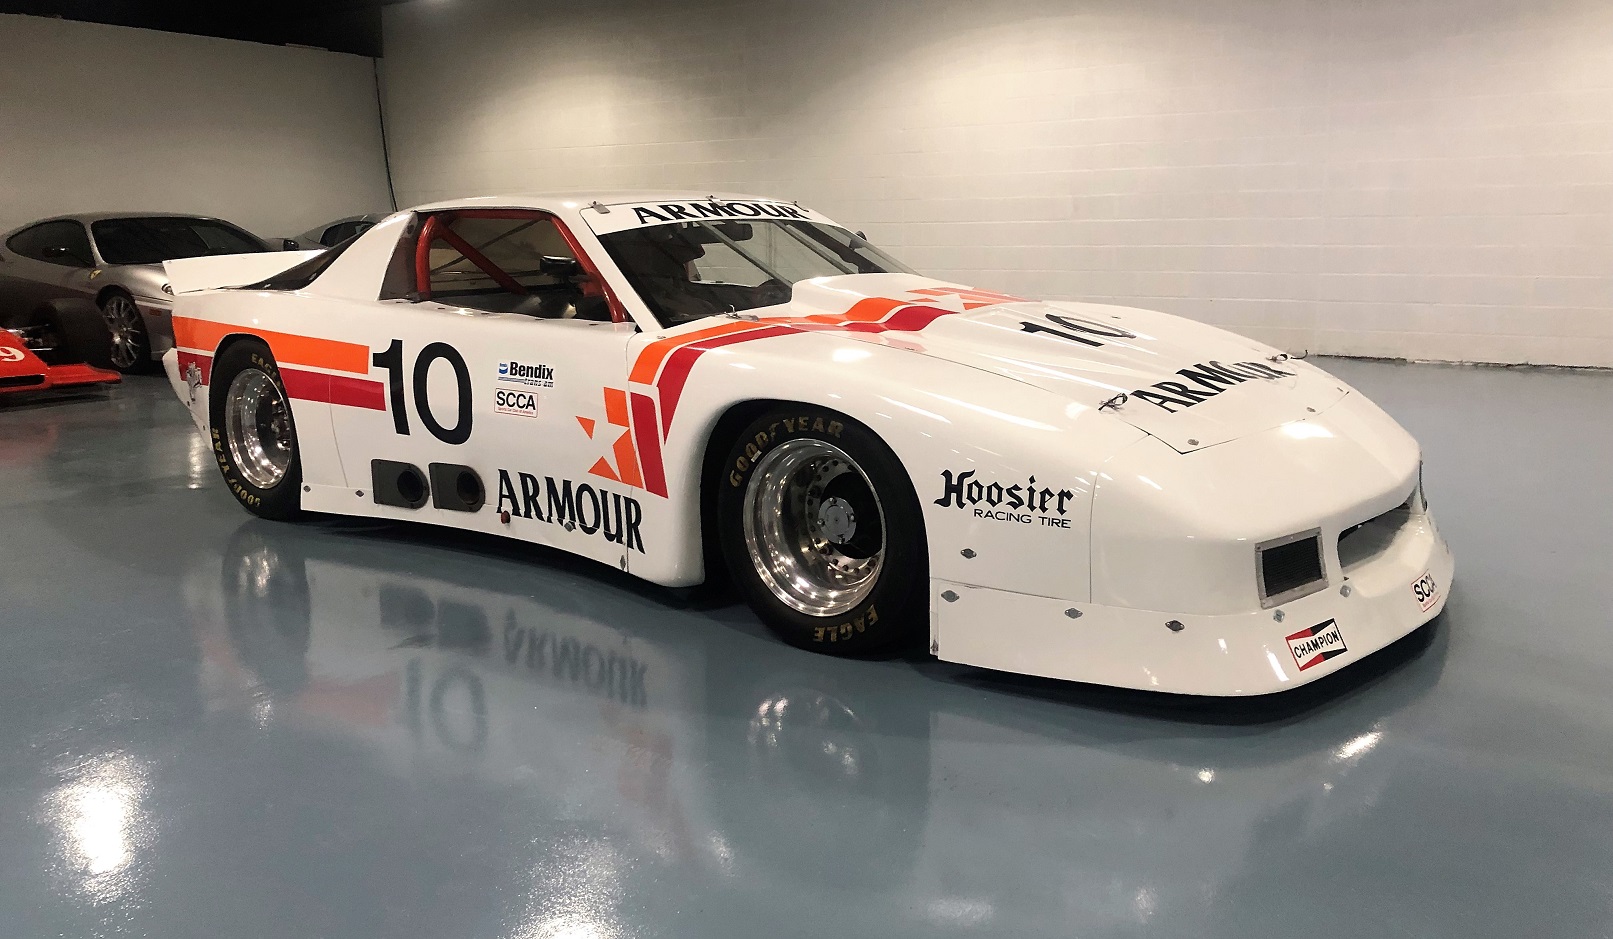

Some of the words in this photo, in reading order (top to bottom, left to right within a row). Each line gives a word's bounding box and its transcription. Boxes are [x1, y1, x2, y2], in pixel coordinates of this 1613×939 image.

[631, 202, 811, 224] ARMOUR
[1019, 313, 1137, 347] 10
[509, 361, 554, 380] Bendix
[372, 338, 473, 445] 10
[496, 391, 536, 411] SCCA
[933, 469, 1074, 516] Hoosier
[496, 468, 646, 554] ARMOUR
[973, 508, 1032, 524] RACING
[1038, 516, 1072, 529] TIRE
[813, 604, 879, 643] EAGLE
[1293, 630, 1340, 659] CHAMPION
